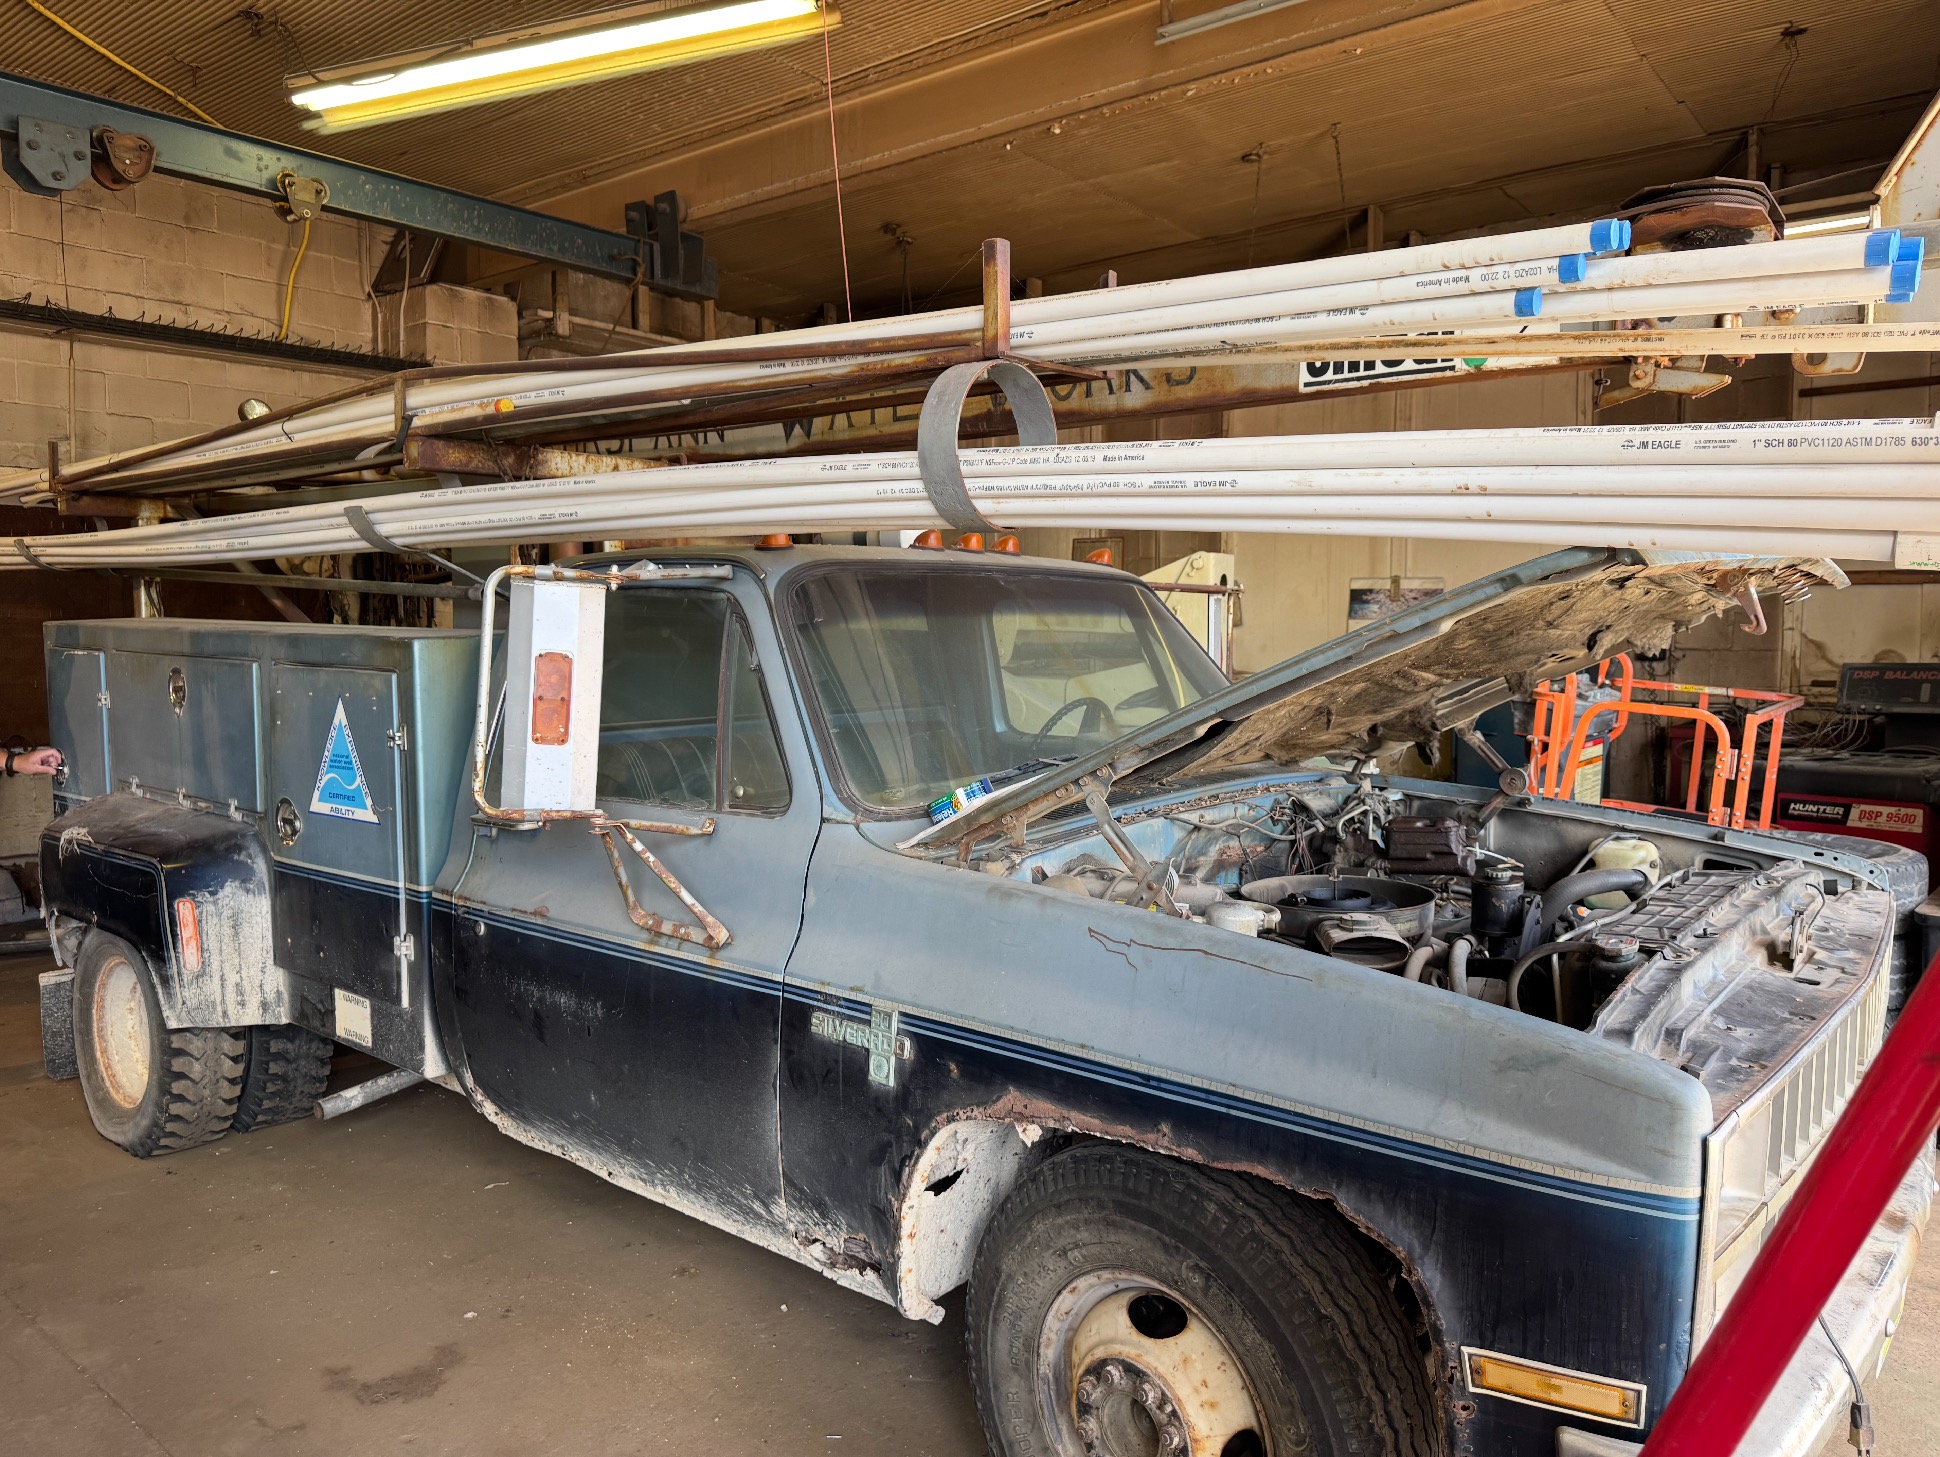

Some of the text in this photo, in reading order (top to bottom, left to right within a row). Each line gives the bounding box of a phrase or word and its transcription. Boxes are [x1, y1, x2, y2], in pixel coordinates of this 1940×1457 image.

[1502, 270, 1510, 279] 12
[1546, 265, 1558, 274] HA
[1416, 277, 1443, 288] America
[1443, 277, 1451, 285] in
[1452, 275, 1470, 285] Made
[1326, 308, 1348, 317] EAGLE
[1636, 440, 1682, 450] JM EAGLE
[1752, 439, 1762, 449] 1"
[1763, 438, 1785, 448] SCH
[1787, 438, 1798, 448] 80
[1800, 437, 1843, 448] PVC1120
[1844, 437, 1873, 447] ASTM
[1874, 436, 1906, 447] D1785
[1102, 454, 1117, 462] Made
[1218, 480, 1229, 488] JM
[1853, 671, 1880, 680] DSP
[316, 722, 338, 792] KNOWLEDGE
[343, 724, 370, 801] EXPERIENCE
[328, 764, 354, 772] association
[328, 792, 356, 802] CERTIFIED
[329, 806, 355, 817] ABILITY
[1788, 802, 1845, 815] HUNTER
[1859, 809, 1917, 824] DSP 9500
[342, 993, 368, 1009] WARNING
[343, 1026, 369, 1045] WARNING
[810, 1011, 911, 1060] SILVERADO
[1003, 1277, 1026, 1328] SUPER
[1006, 1390, 1037, 1457] OPER
